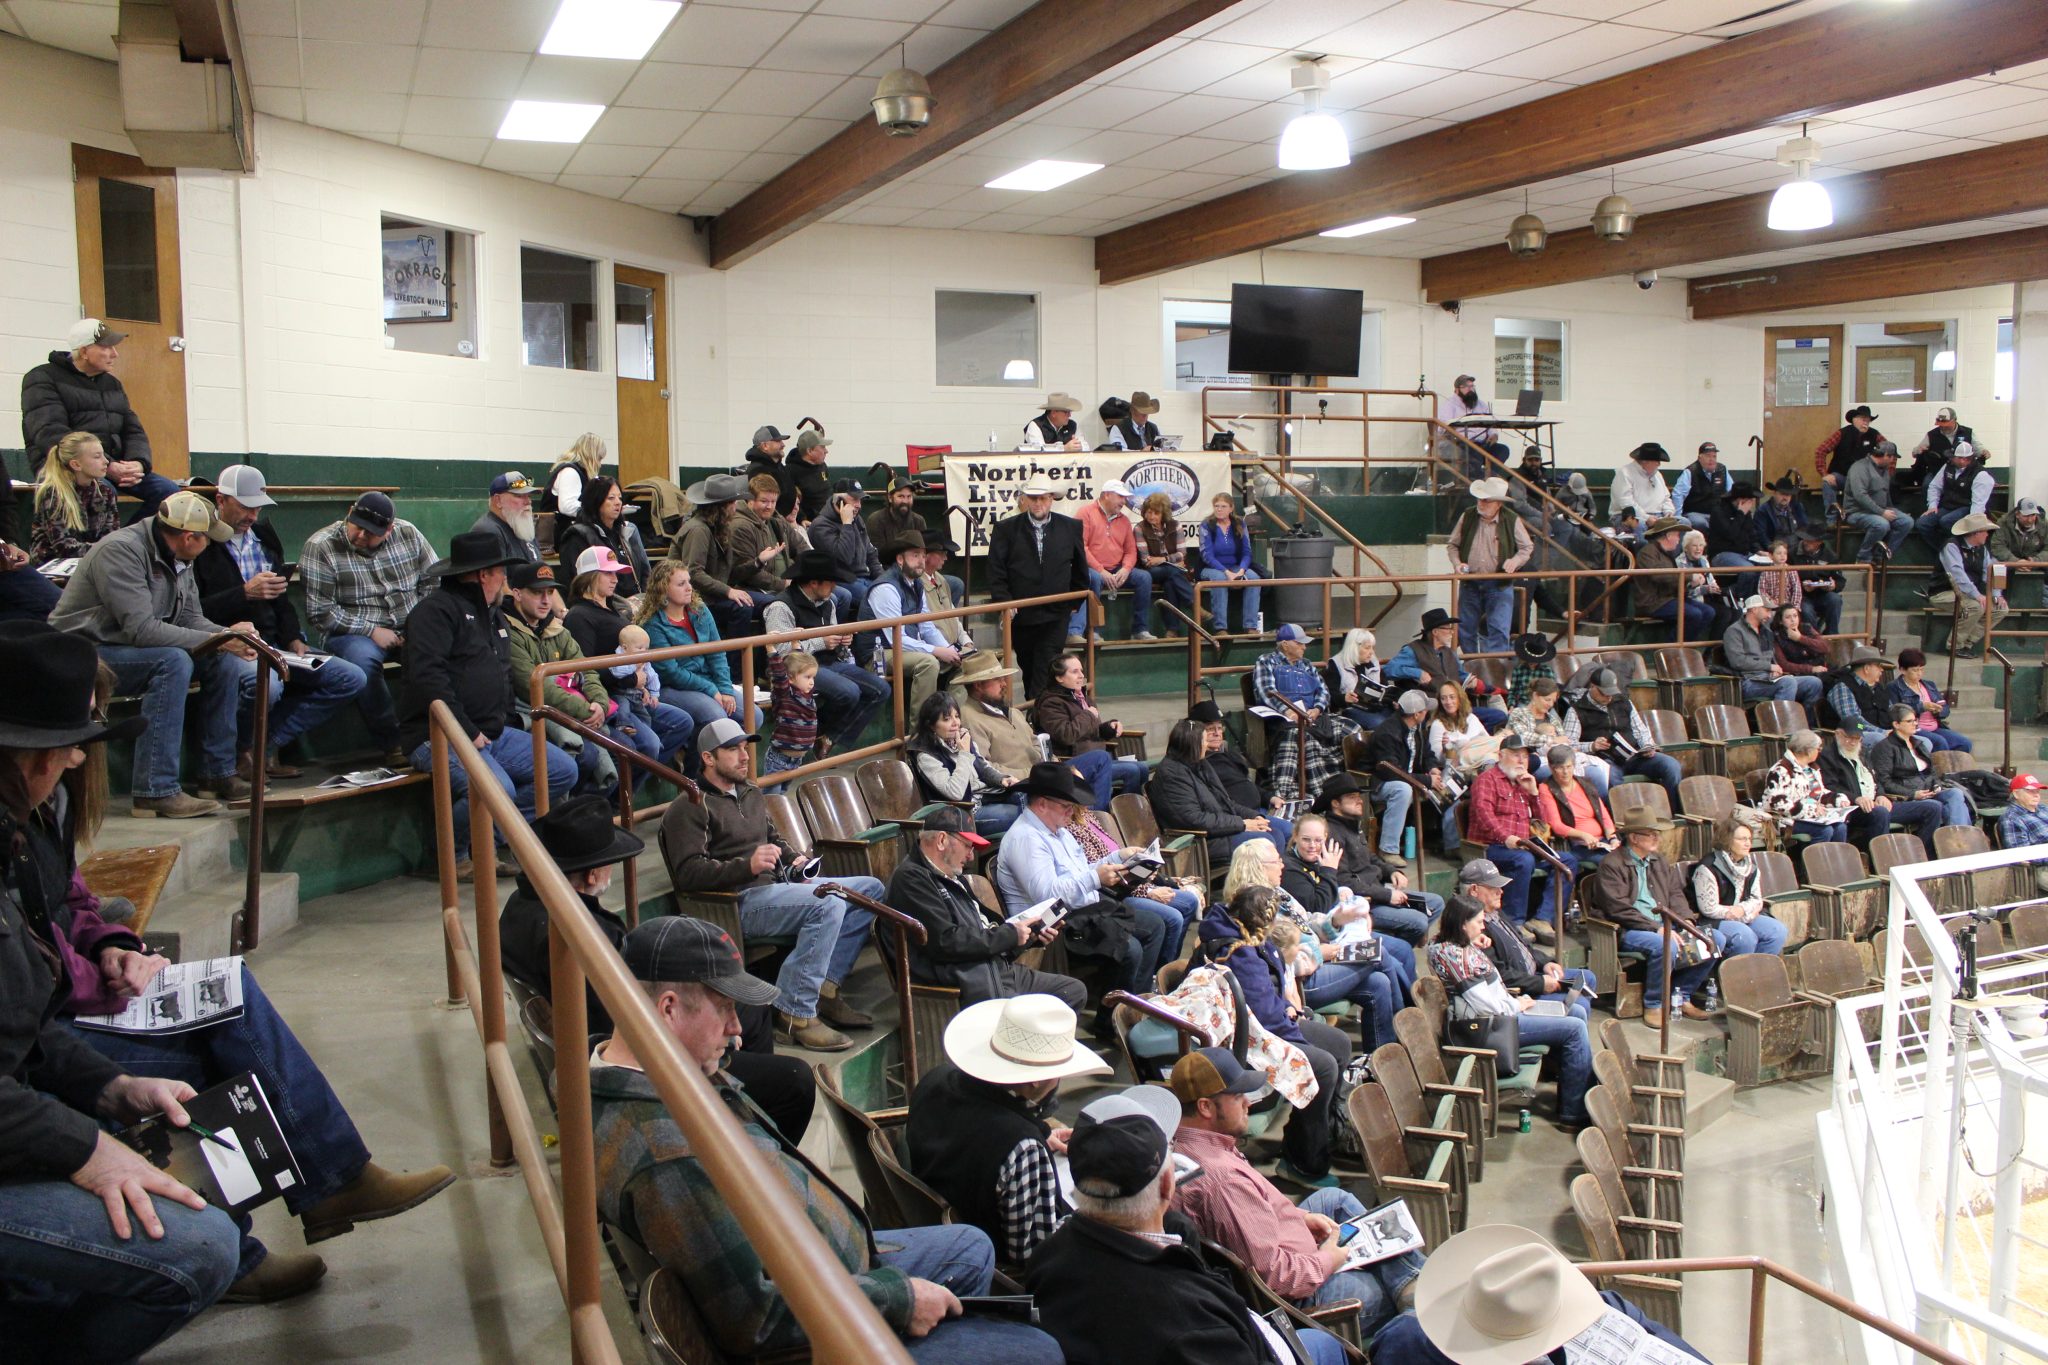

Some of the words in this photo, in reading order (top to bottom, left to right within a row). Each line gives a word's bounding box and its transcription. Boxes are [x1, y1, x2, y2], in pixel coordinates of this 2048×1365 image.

[395, 262, 457, 287] OKRAGL
[394, 292, 425, 304] LIVESTOCK
[427, 298, 458, 310] MARKENG
[968, 462, 1092, 482] Northern
[1128, 466, 1191, 491] NORTHERN
